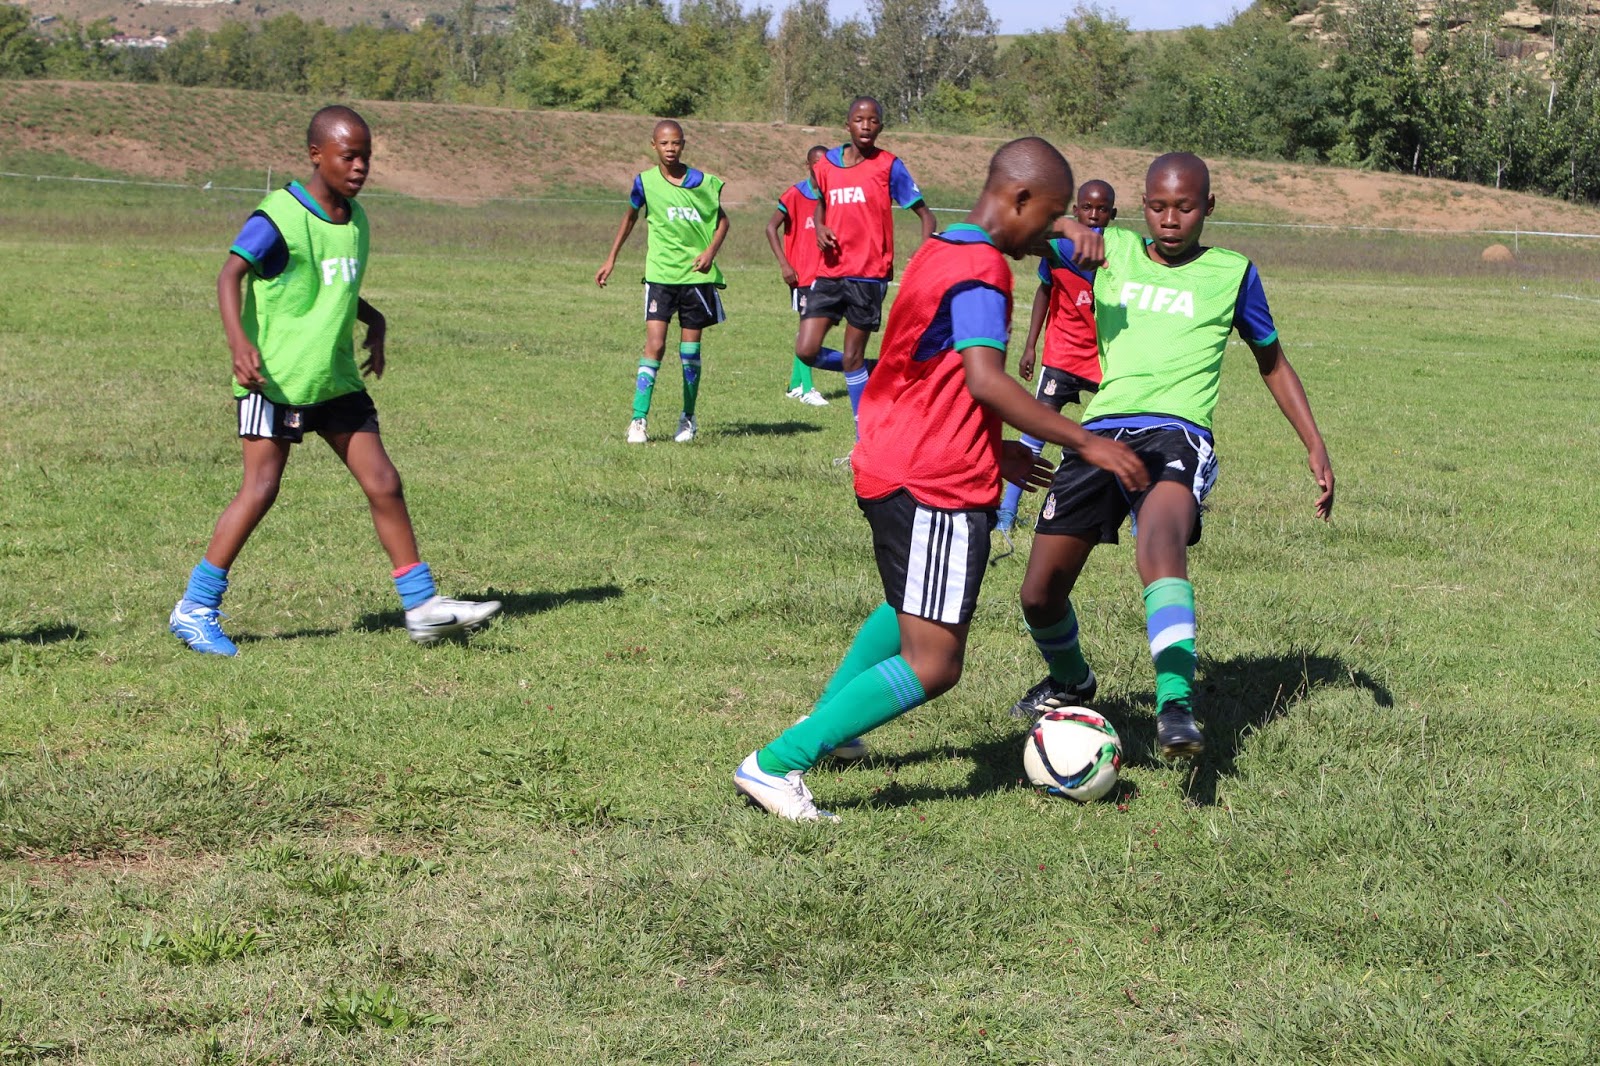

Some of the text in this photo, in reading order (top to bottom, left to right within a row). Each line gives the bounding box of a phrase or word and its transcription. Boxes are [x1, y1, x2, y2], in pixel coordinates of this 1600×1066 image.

[830, 187, 866, 206] FIFA
[668, 207, 702, 222] FIFA
[1120, 282, 1194, 318] FIFA
